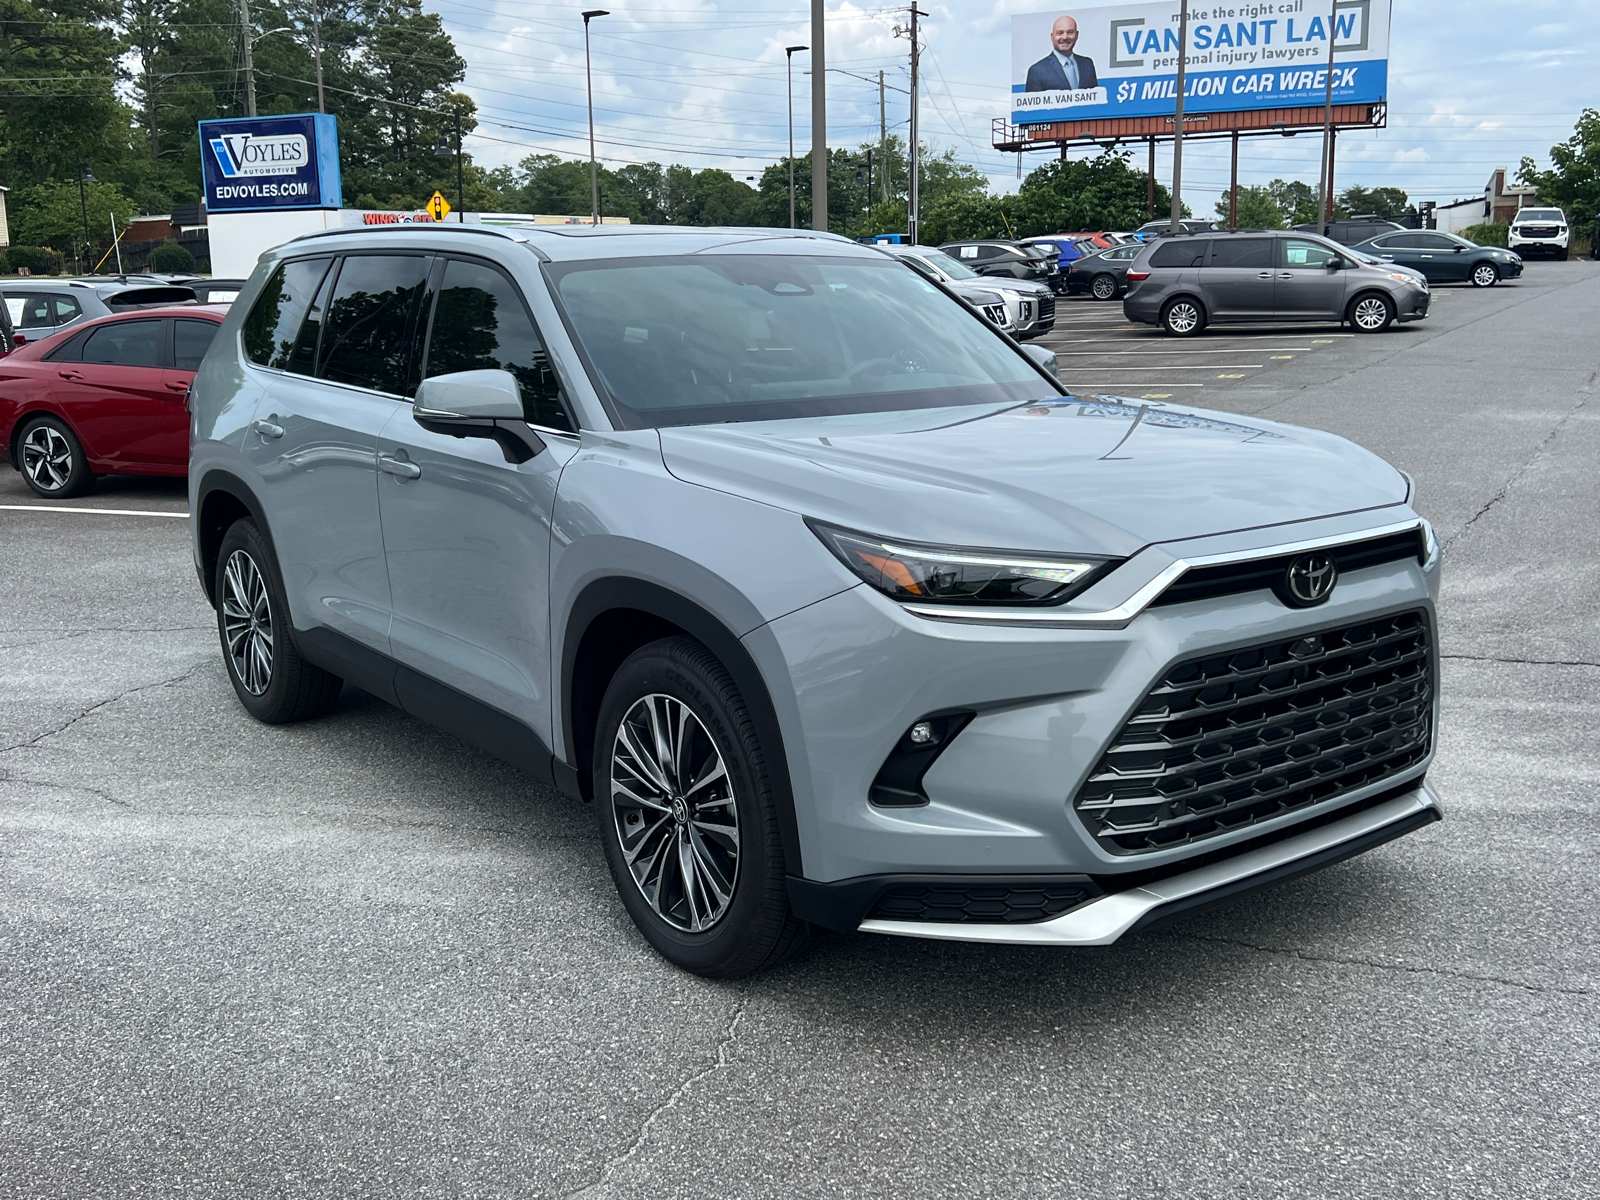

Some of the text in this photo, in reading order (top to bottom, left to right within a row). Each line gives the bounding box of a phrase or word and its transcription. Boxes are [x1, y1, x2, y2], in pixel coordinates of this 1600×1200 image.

[1171, 0, 1303, 22] make the right call
[1122, 13, 1356, 55] VAN SANT LAW
[1153, 47, 1319, 70] personal injury lawyers
[1116, 81, 1138, 104] $1
[1231, 73, 1275, 95] CAR
[1279, 67, 1359, 91] WRECK
[1016, 92, 1098, 107] DAVID M. VAN SANT
[223, 136, 302, 172] VOYLES
[243, 167, 295, 175] AUTOMOTIVE
[216, 182, 308, 199] EDVOYLES.COM
[363, 213, 398, 225] WING
